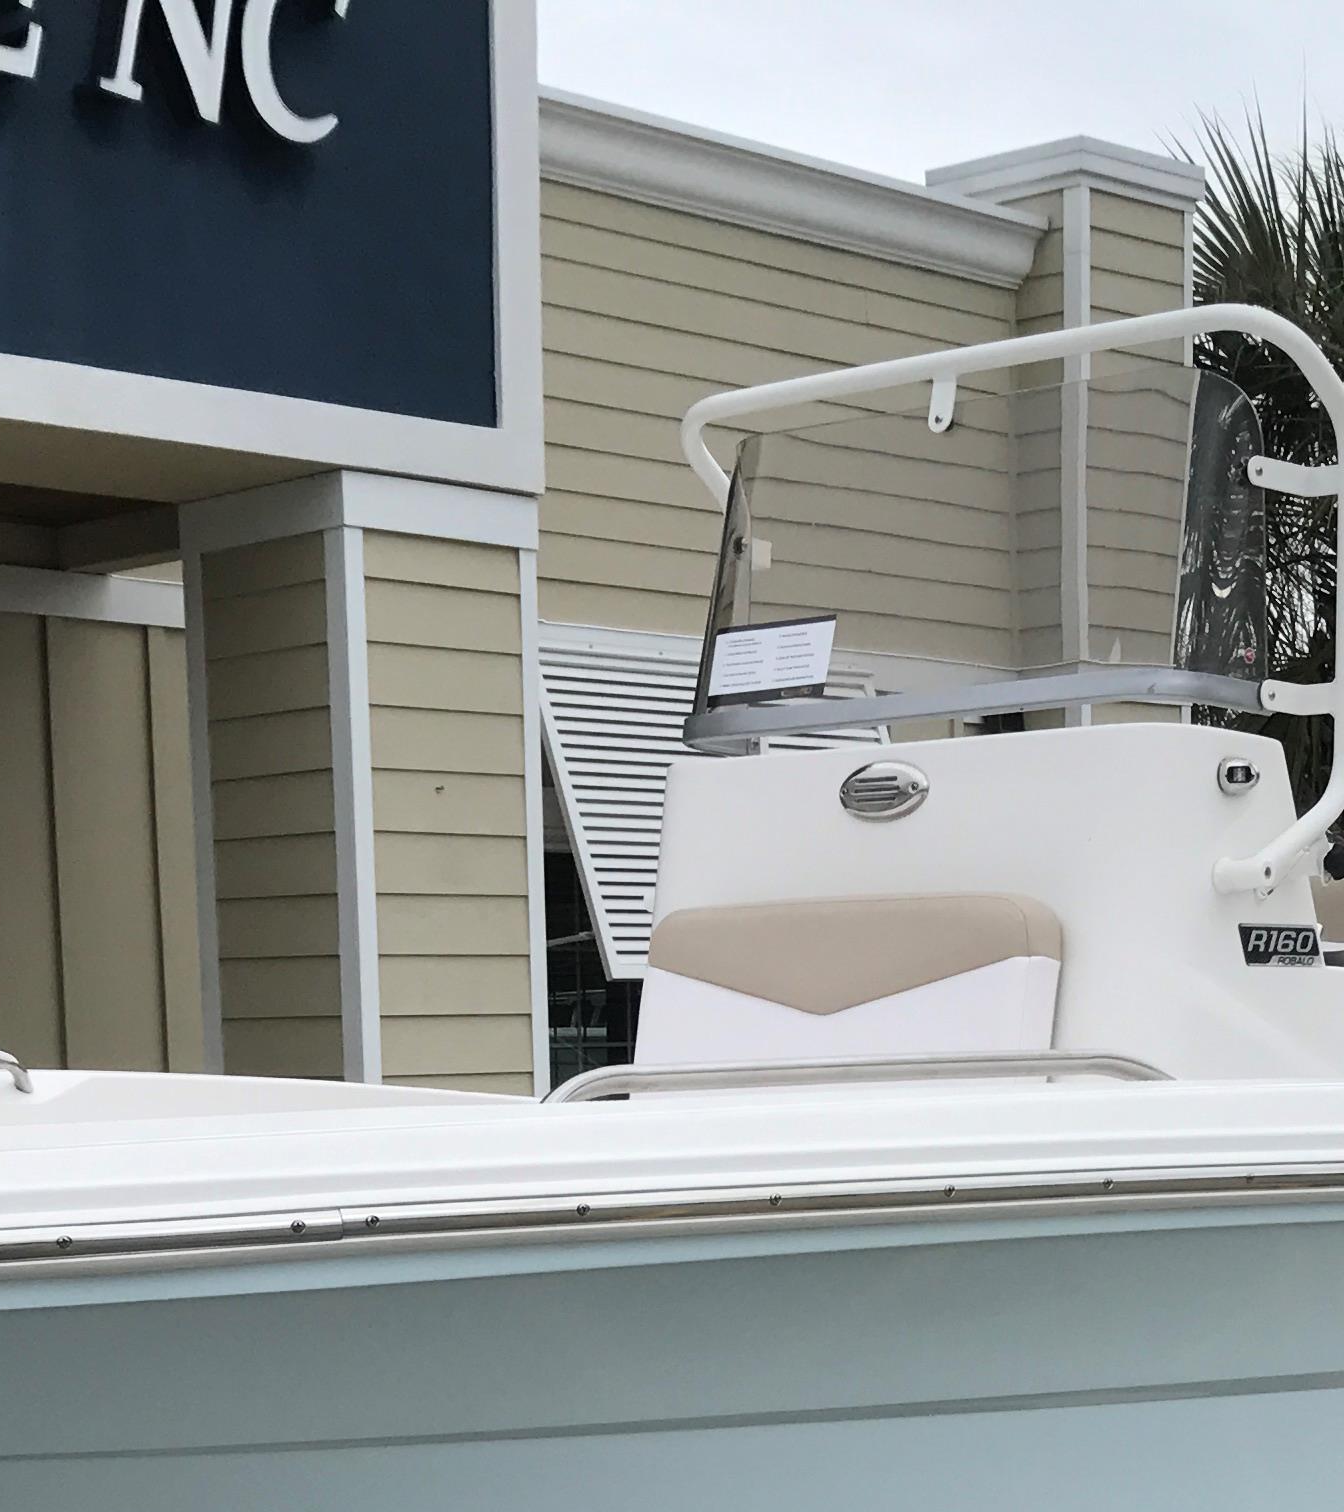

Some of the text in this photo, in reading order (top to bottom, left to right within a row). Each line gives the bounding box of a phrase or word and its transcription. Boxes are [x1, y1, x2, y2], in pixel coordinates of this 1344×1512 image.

[99, 0, 347, 144] NC
[1247, 929, 1314, 953] R160
[1277, 956, 1314, 966] ROBALO
